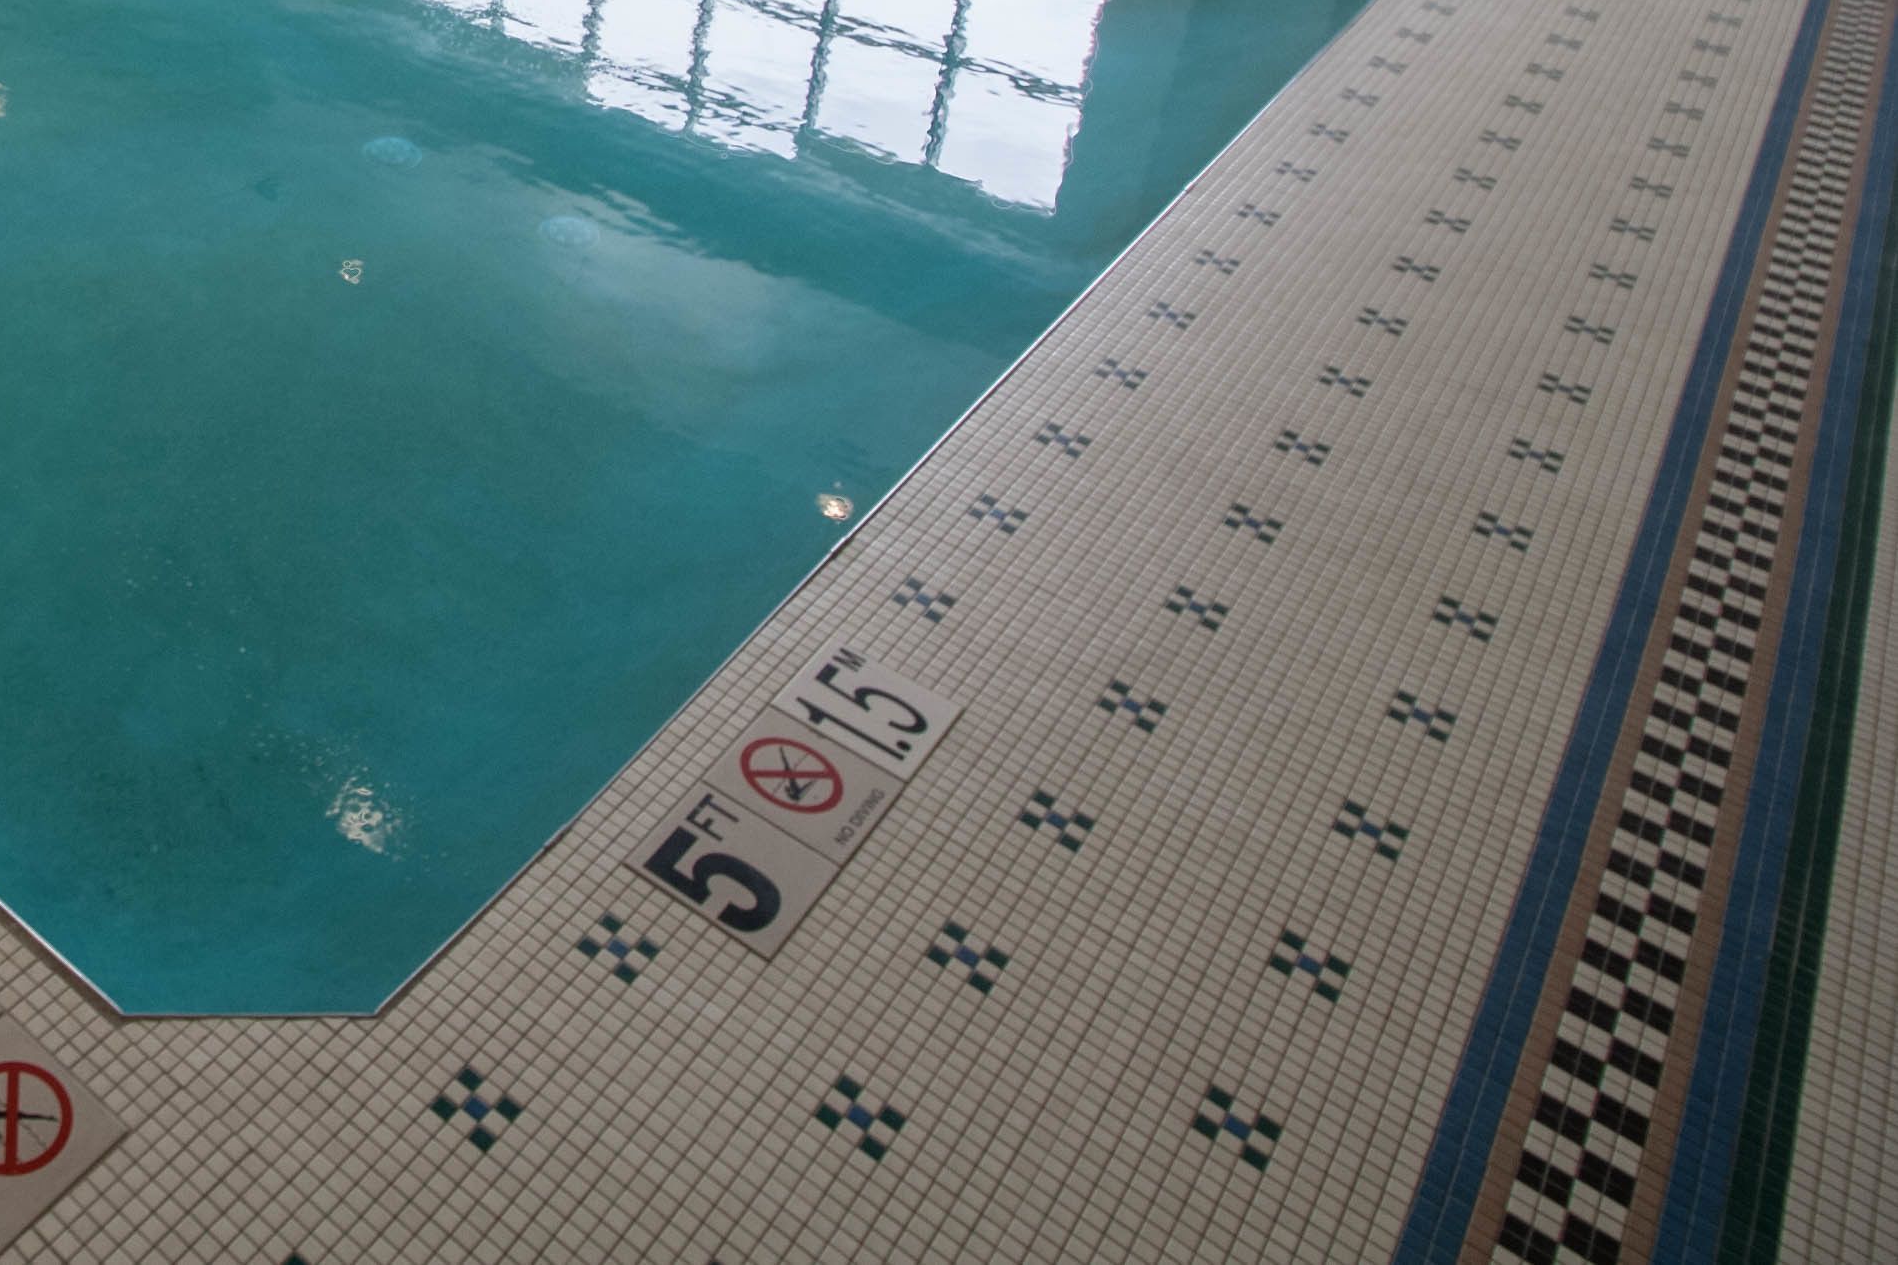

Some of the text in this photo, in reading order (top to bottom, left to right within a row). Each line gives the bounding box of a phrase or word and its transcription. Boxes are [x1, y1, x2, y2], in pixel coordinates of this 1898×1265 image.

[796, 646, 929, 761] 1.5 M
[643, 793, 782, 933] 5 FT
[834, 787, 886, 846] NO DIVING
